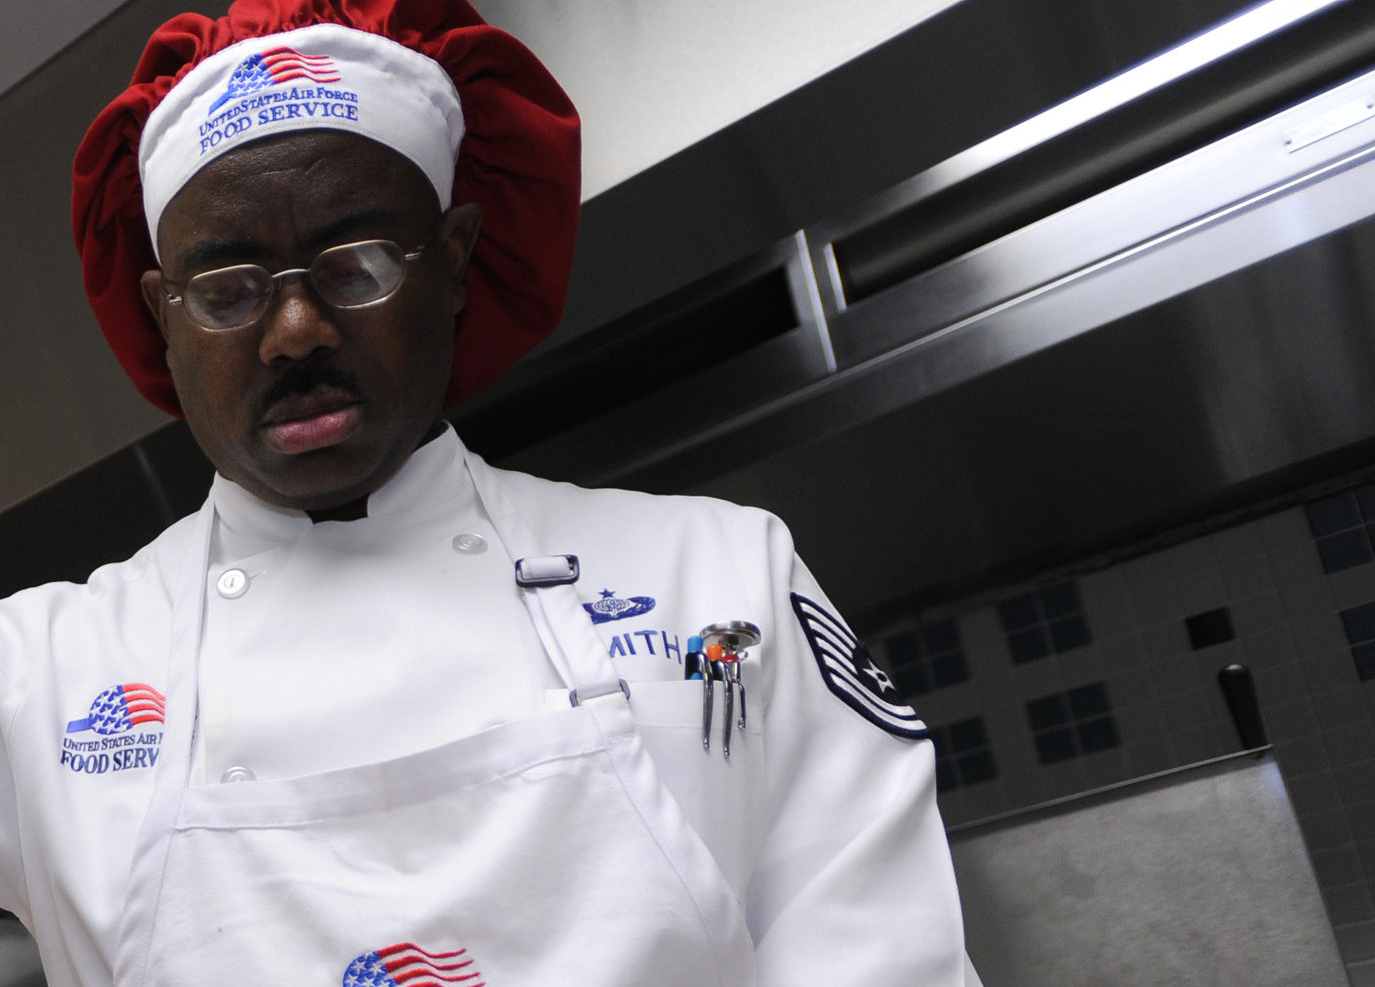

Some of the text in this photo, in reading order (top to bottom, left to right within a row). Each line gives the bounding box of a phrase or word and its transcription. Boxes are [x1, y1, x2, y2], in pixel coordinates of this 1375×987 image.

[199, 101, 359, 156] FOOD SERVICE
[609, 629, 683, 665] MITH
[63, 737, 100, 752] UNITED
[101, 734, 136, 751] STATES
[136, 732, 156, 746] AIR
[60, 747, 160, 774] FOOD SERV
